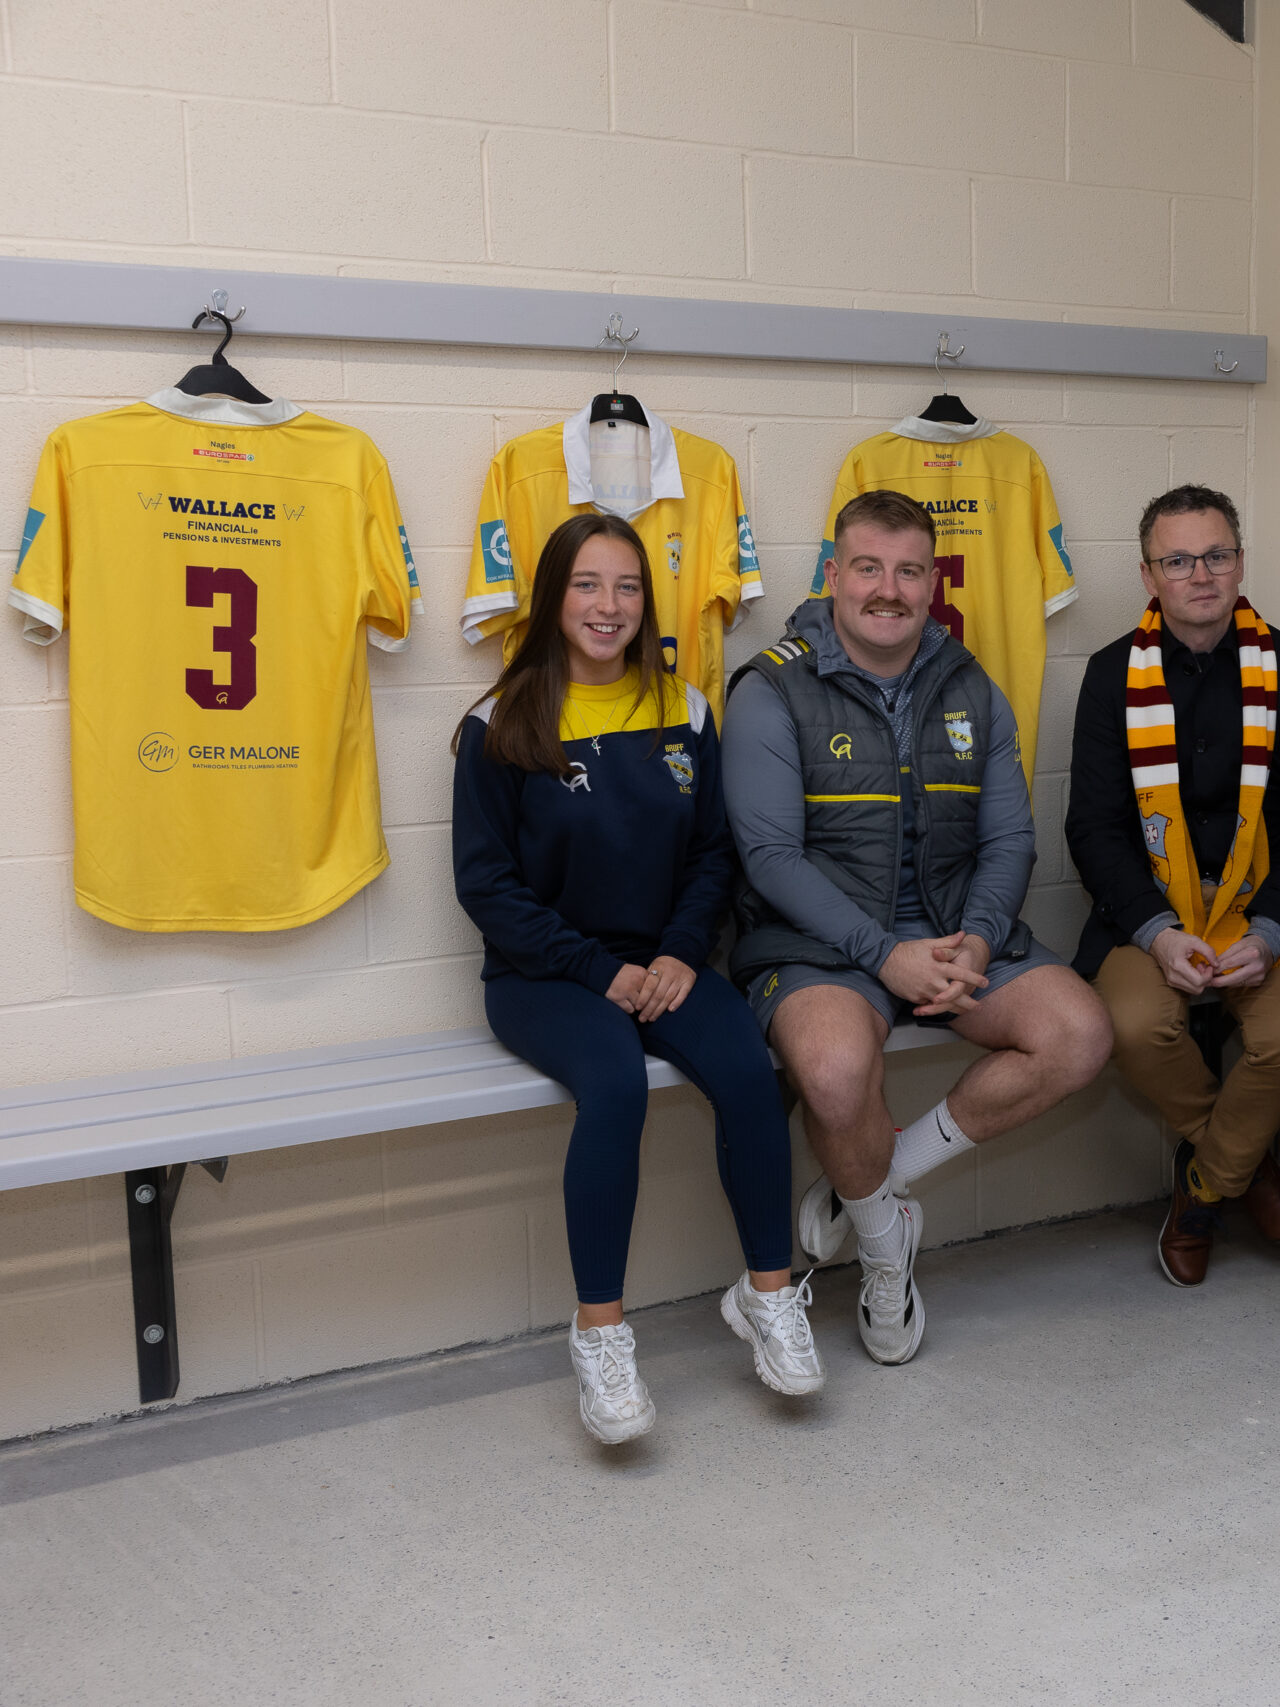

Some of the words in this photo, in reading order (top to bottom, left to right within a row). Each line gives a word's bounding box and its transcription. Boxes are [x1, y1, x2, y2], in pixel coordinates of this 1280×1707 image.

[210, 441, 236, 450] Nagles
[168, 496, 276, 520] WALLACE
[918, 499, 978, 514] ALLACE
[187, 520, 258, 535] FINANCIAL.ie
[163, 532, 210, 543] PENSIONS
[220, 537, 282, 547] INVESTMENTS
[185, 565, 258, 711] 3
[944, 711, 967, 721] BRUFF
[188, 745, 225, 759] GER
[230, 746, 300, 760] MALONE
[664, 743, 685, 752] BRUFF
